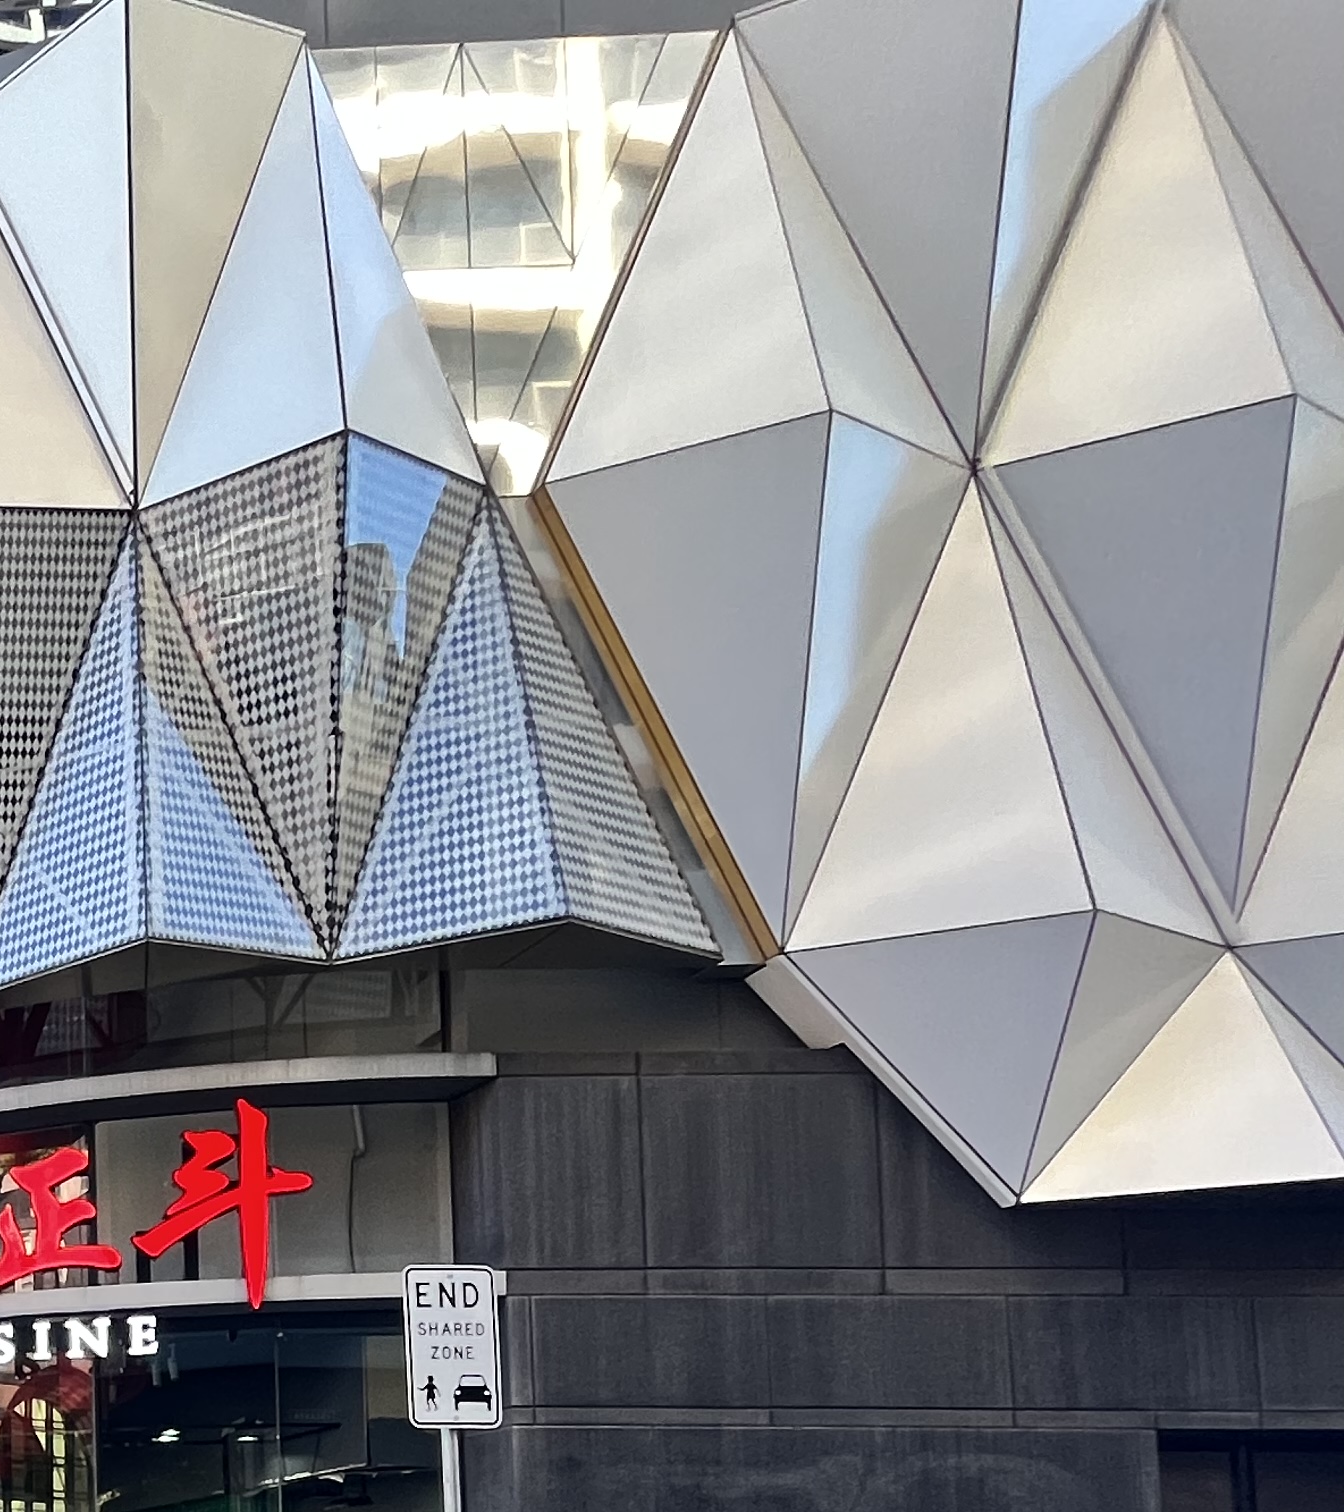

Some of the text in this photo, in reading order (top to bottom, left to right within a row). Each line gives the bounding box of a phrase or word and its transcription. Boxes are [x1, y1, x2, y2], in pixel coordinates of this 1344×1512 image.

[415, 1282, 479, 1309] END
[417, 1322, 486, 1337] SHARED
[430, 1345, 476, 1361] ZONE
